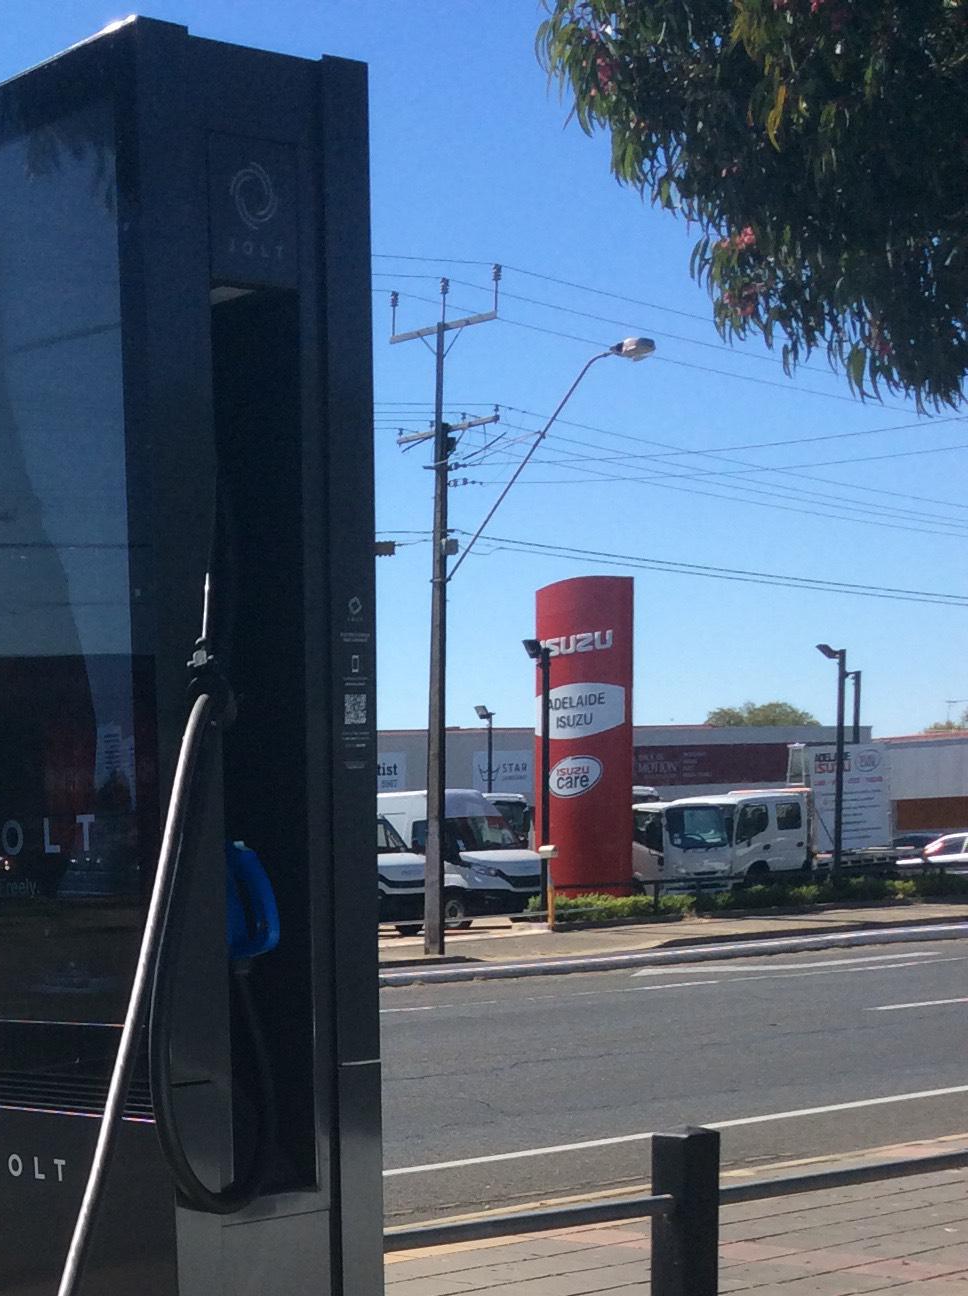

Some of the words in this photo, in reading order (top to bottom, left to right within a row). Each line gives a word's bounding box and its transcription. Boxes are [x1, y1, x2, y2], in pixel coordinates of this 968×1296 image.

[540, 629, 613, 657] ISUZU
[548, 692, 606, 711] ADELAIDE
[556, 713, 593, 729] ISUZU
[556, 766, 590, 777] ISUZU
[556, 775, 589, 790] care
